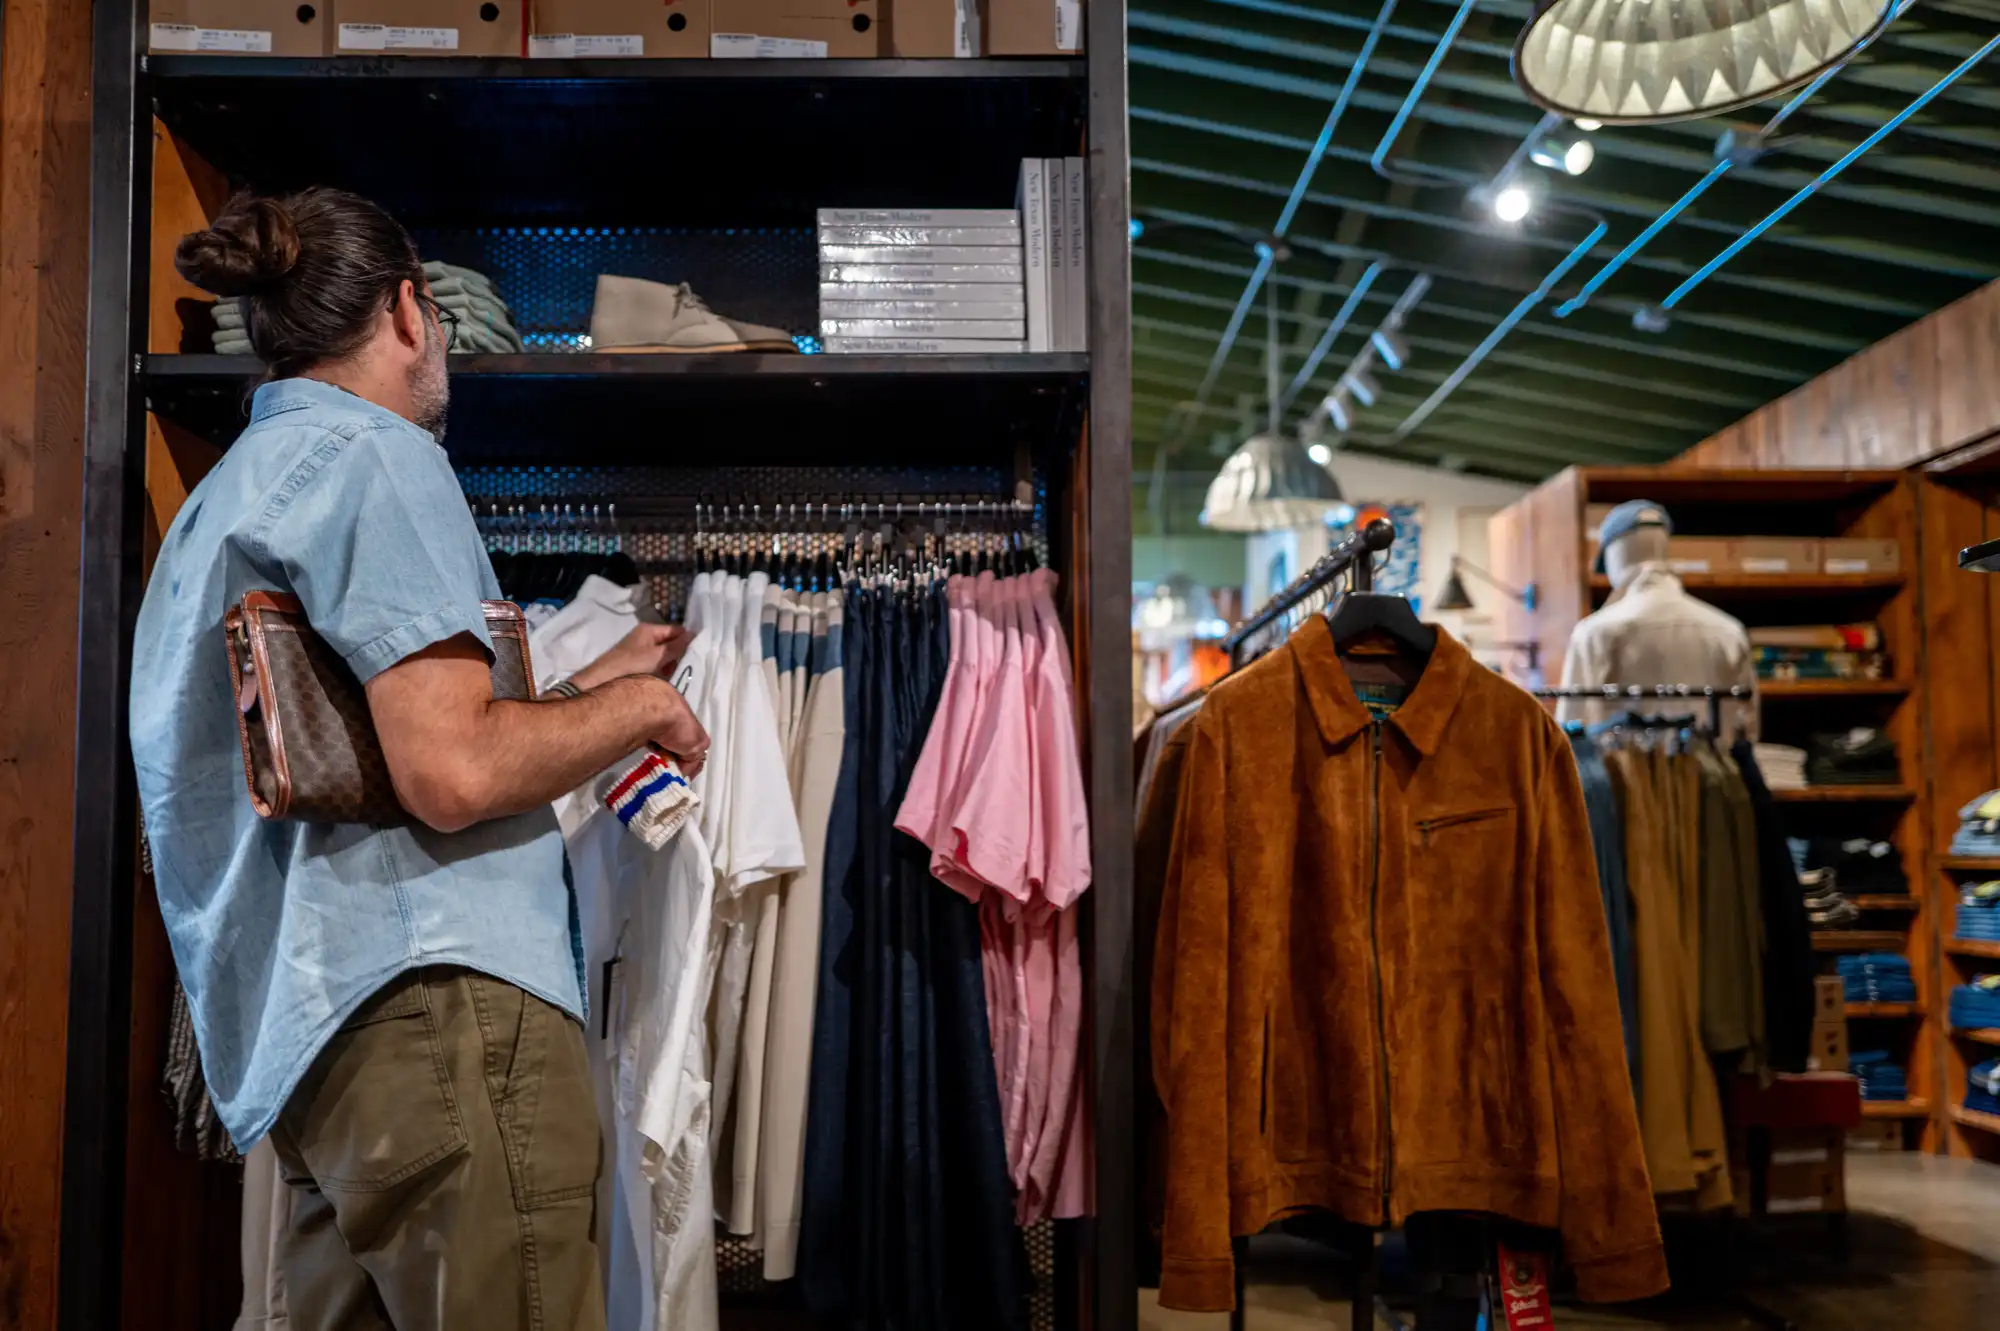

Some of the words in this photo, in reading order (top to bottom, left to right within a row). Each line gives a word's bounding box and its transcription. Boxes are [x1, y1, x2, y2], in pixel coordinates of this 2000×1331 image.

[1030, 171, 1040, 194] New
[1051, 172, 1061, 194] New
[1070, 172, 1080, 194] New
[833, 211, 856, 222] New
[859, 211, 888, 222] Texas
[891, 211, 932, 222] Modern
[1030, 198, 1041, 226] Texas
[1051, 198, 1061, 226] Texas
[1031, 227, 1042, 268] Modern
[1051, 227, 1062, 268] Modern
[1071, 227, 1082, 268] Modern
[897, 341, 938, 352] Modern
